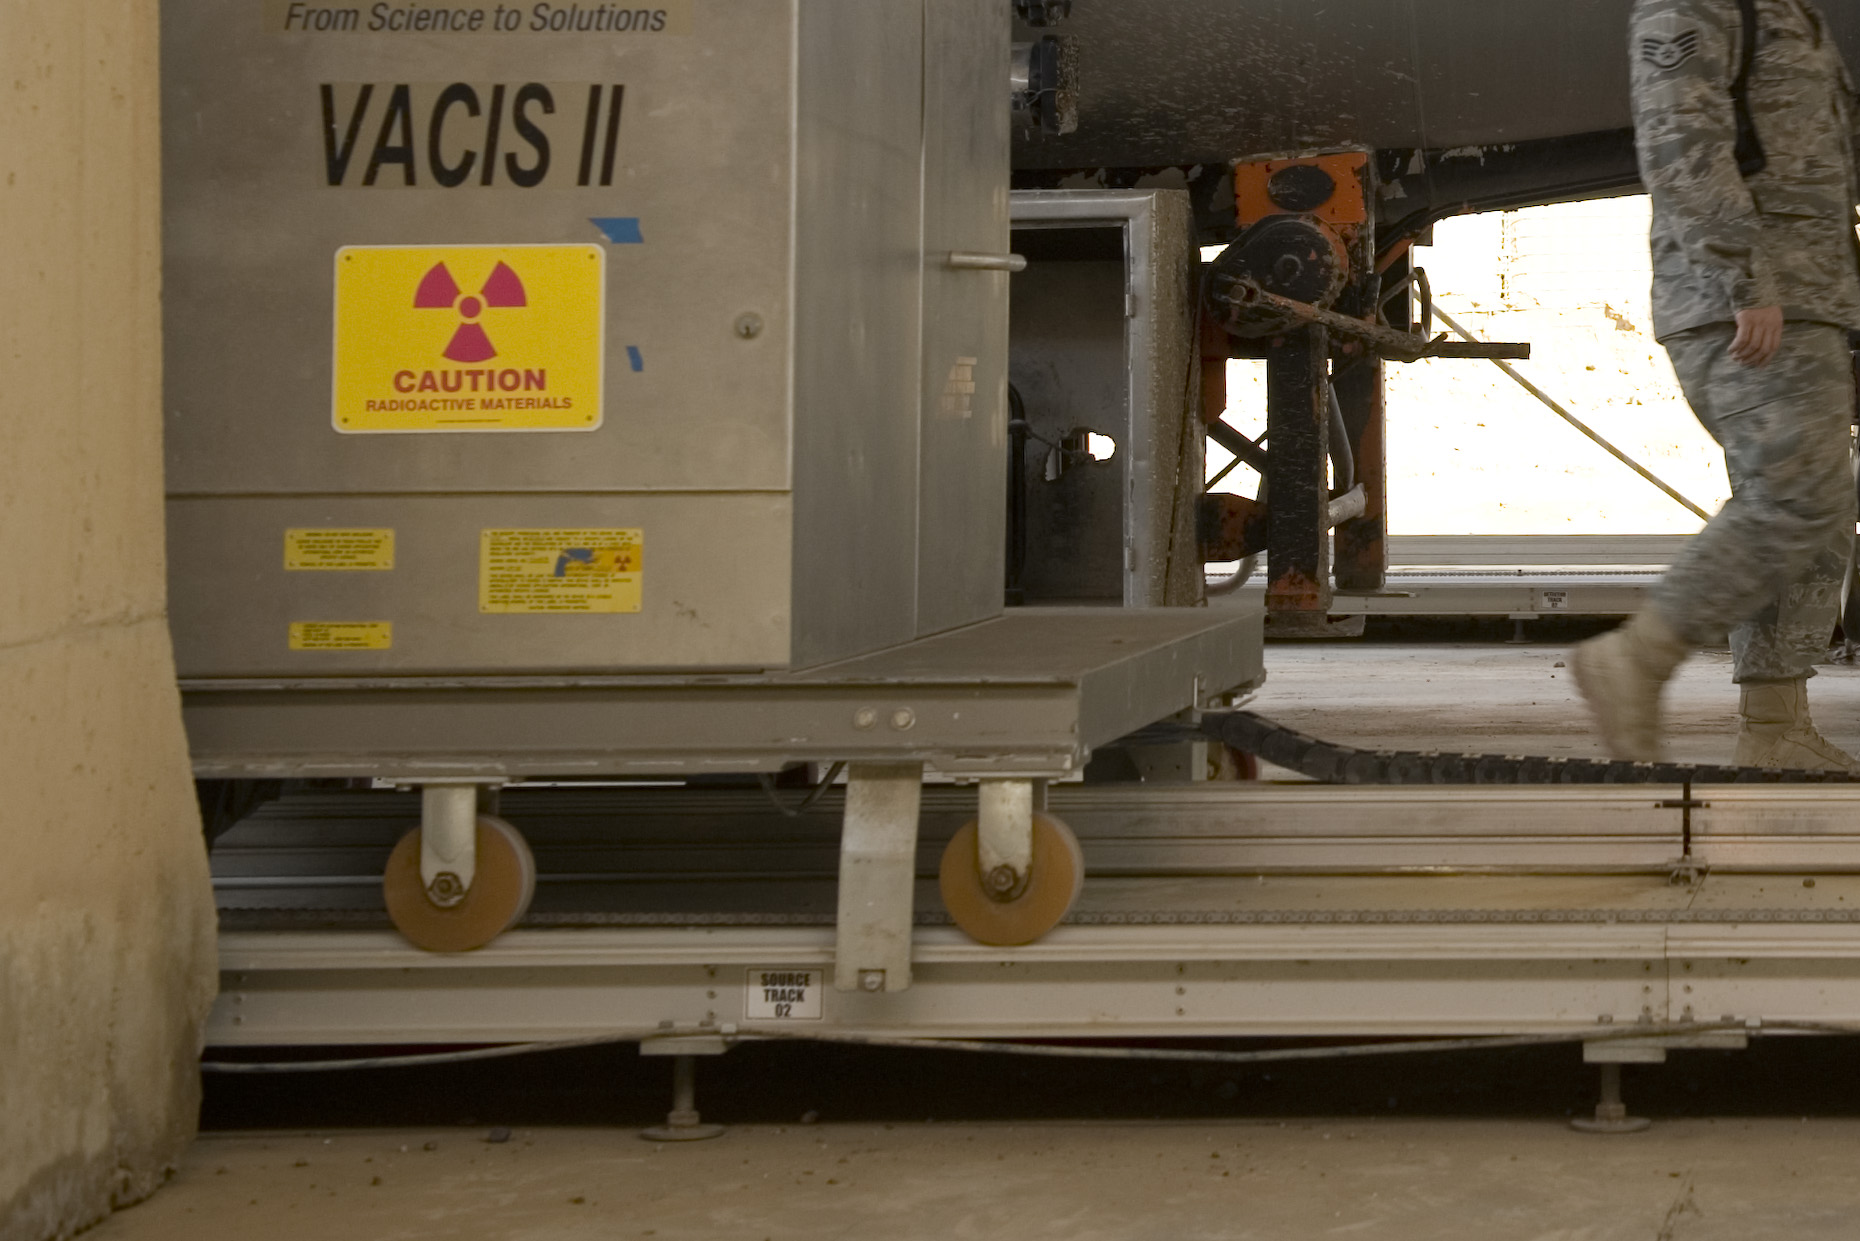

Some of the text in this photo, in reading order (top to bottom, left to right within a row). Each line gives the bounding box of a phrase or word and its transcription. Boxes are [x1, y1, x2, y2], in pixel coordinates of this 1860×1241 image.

[284, 2, 668, 32] From Science to Solutions
[320, 82, 625, 188] VACIS II
[393, 368, 547, 393] CAUTION
[366, 397, 572, 412] RADIOACTIVE MATERIALS
[761, 972, 811, 986] SOURCE
[764, 988, 805, 1002] TRACK
[775, 1003, 792, 1017] 02
